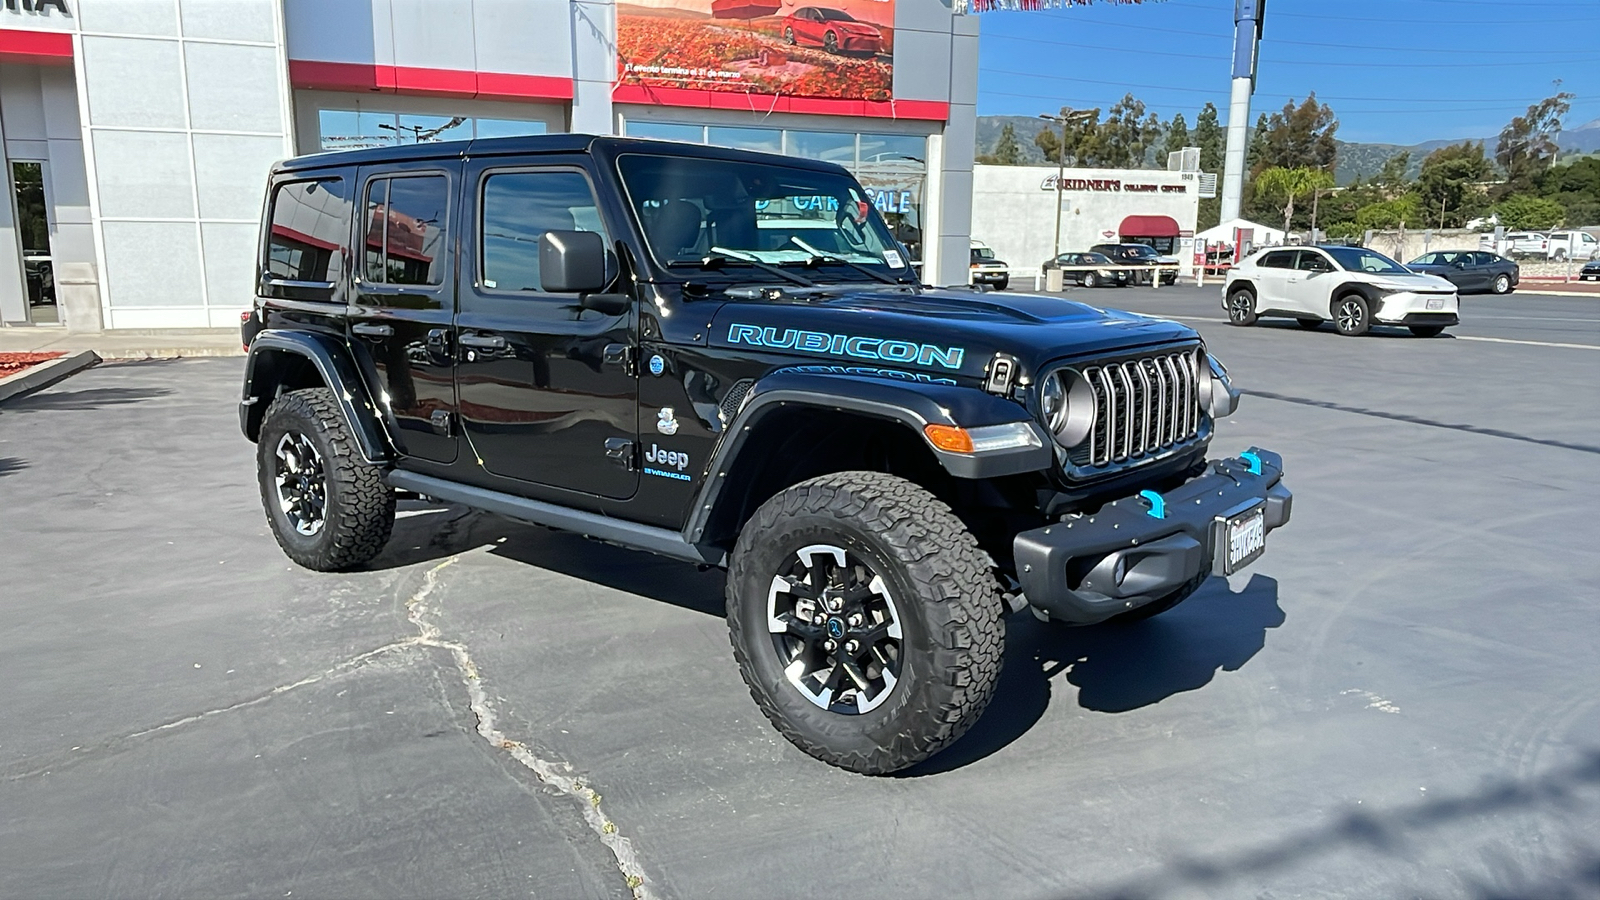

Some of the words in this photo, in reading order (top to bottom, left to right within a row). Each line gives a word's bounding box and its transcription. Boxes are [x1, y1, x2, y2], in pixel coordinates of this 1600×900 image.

[625, 63, 633, 71] El
[633, 65, 660, 73] evento
[660, 66, 689, 75] termina
[689, 68, 698, 76] el
[707, 70, 717, 78] de
[865, 188, 911, 214] SALE
[727, 323, 964, 369] RUBICON
[645, 443, 689, 471] Jeep
